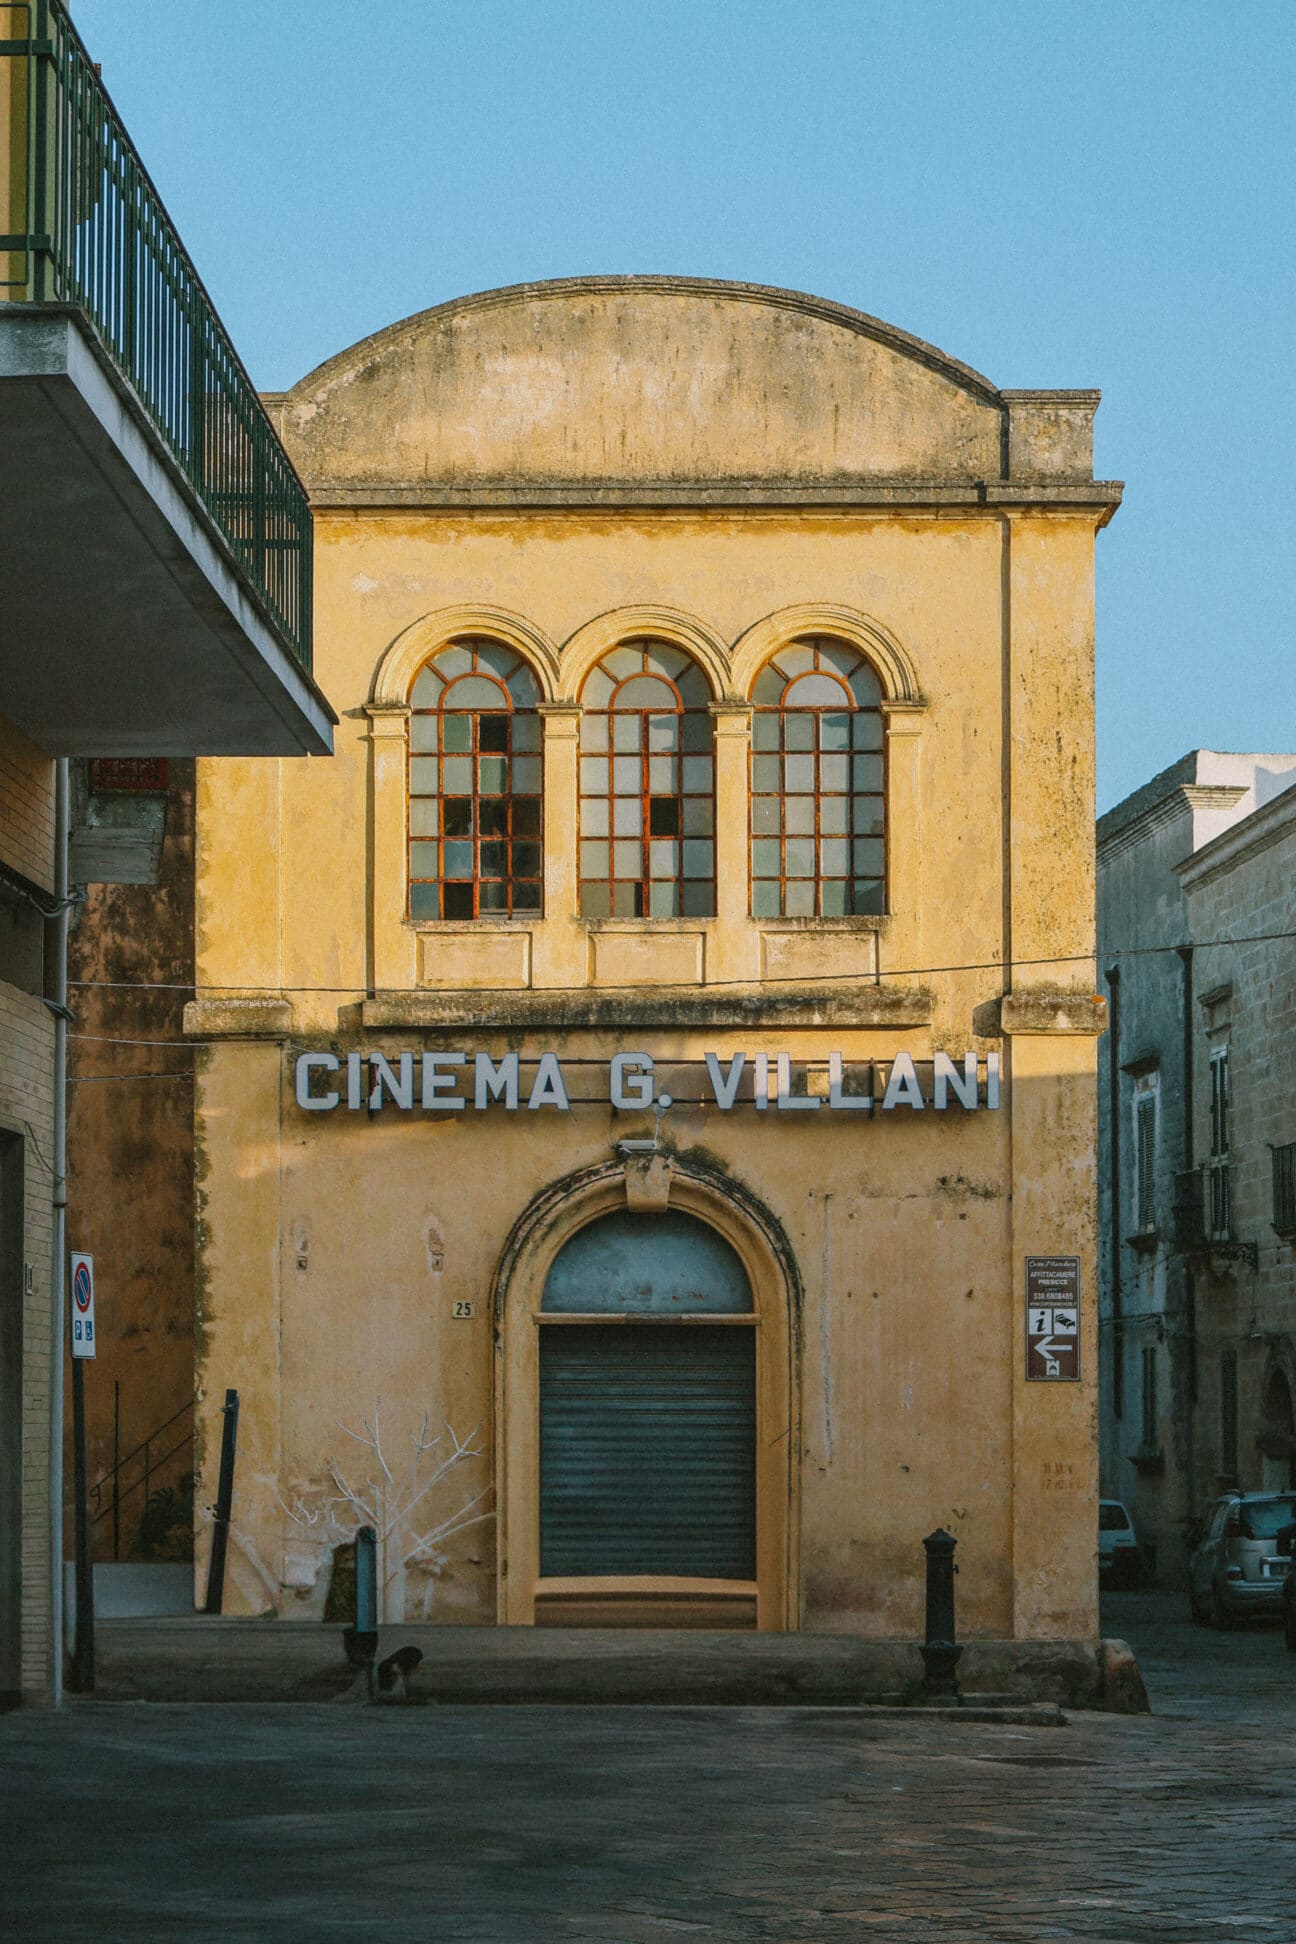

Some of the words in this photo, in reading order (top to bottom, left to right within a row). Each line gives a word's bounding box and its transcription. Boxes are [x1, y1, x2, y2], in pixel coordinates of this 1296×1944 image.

[296, 1051, 571, 1112] CINEMA
[608, 1051, 672, 1111] G.
[704, 1051, 1002, 1112] VILLANI
[456, 1302, 471, 1316] 25
